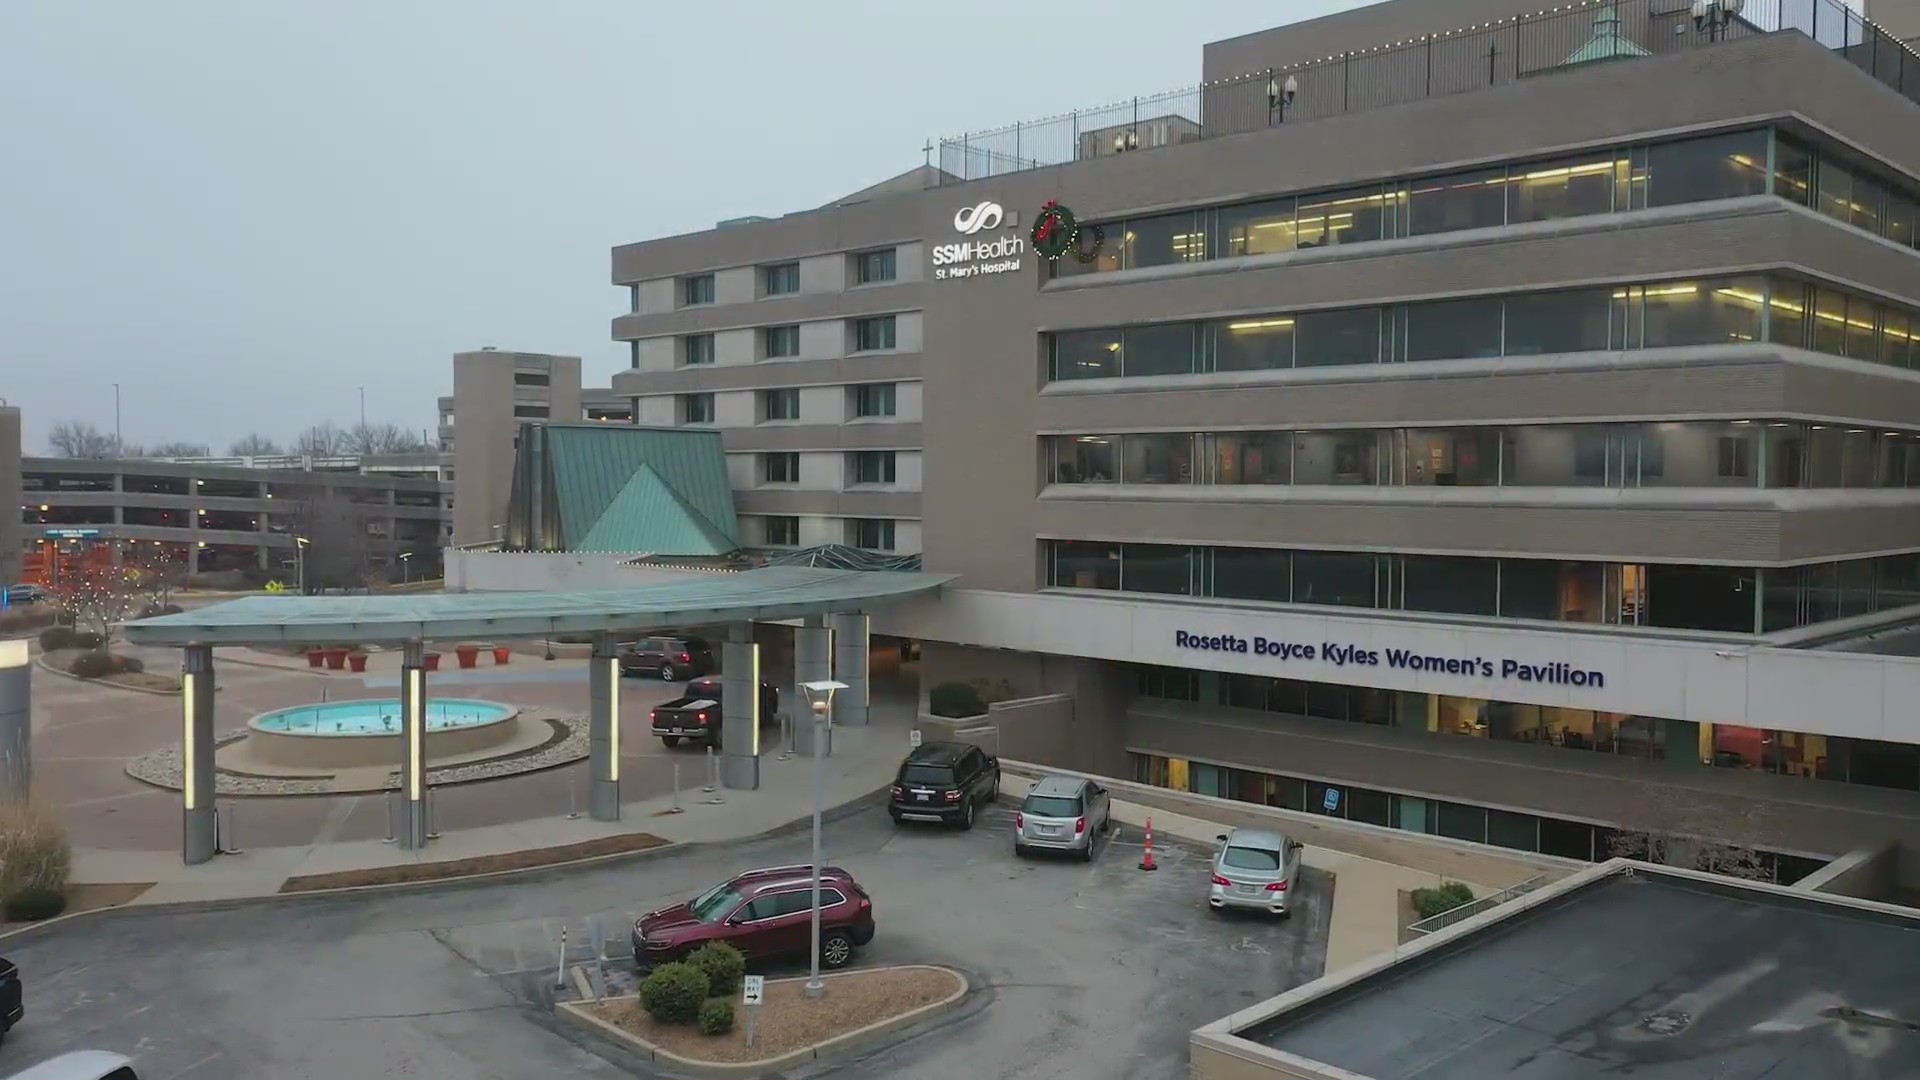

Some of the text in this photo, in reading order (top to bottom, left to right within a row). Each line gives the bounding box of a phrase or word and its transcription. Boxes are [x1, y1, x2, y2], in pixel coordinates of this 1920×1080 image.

[936, 259, 1020, 280] St. Mary's Hospital
[1176, 630, 1604, 688] Rosetta Boyce Kyles Women's Pavilion
